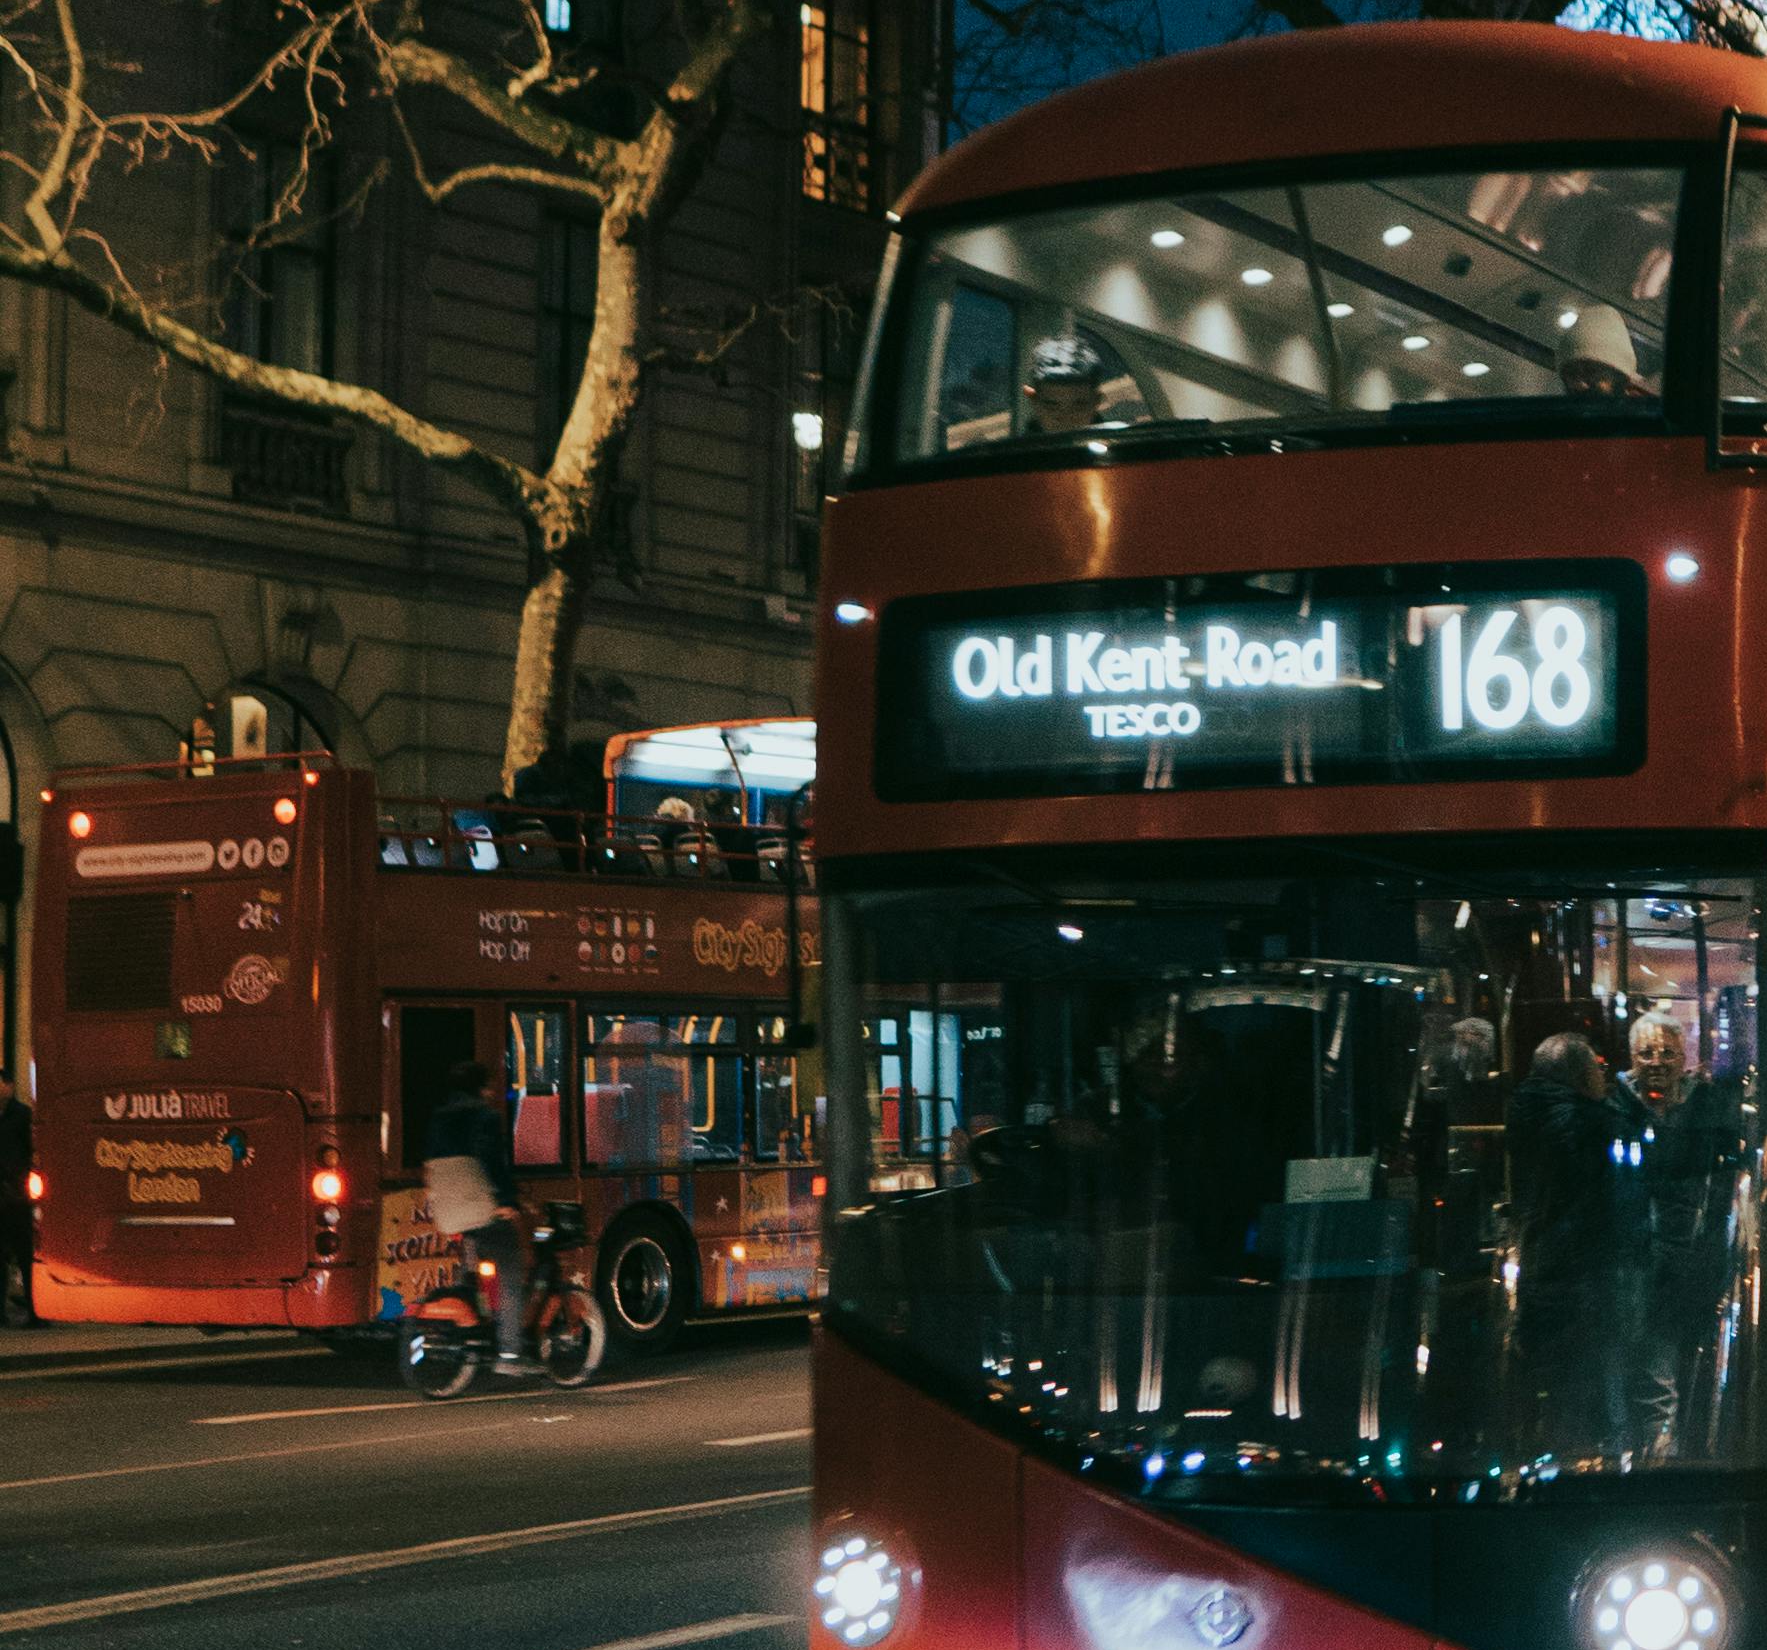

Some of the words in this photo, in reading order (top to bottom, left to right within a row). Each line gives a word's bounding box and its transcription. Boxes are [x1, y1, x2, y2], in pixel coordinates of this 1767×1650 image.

[952, 635, 1051, 701] Old
[1066, 630, 1190, 693] Kent
[1206, 621, 1337, 688] Road
[1439, 605, 1592, 732] 168
[1085, 703, 1201, 738] TESCO
[479, 910, 507, 933] Hop
[510, 910, 529, 933] On
[479, 938, 507, 962] Hop
[510, 938, 531, 961] Off
[183, 1093, 232, 1120] TRAVEL
[128, 1171, 201, 1204] London
